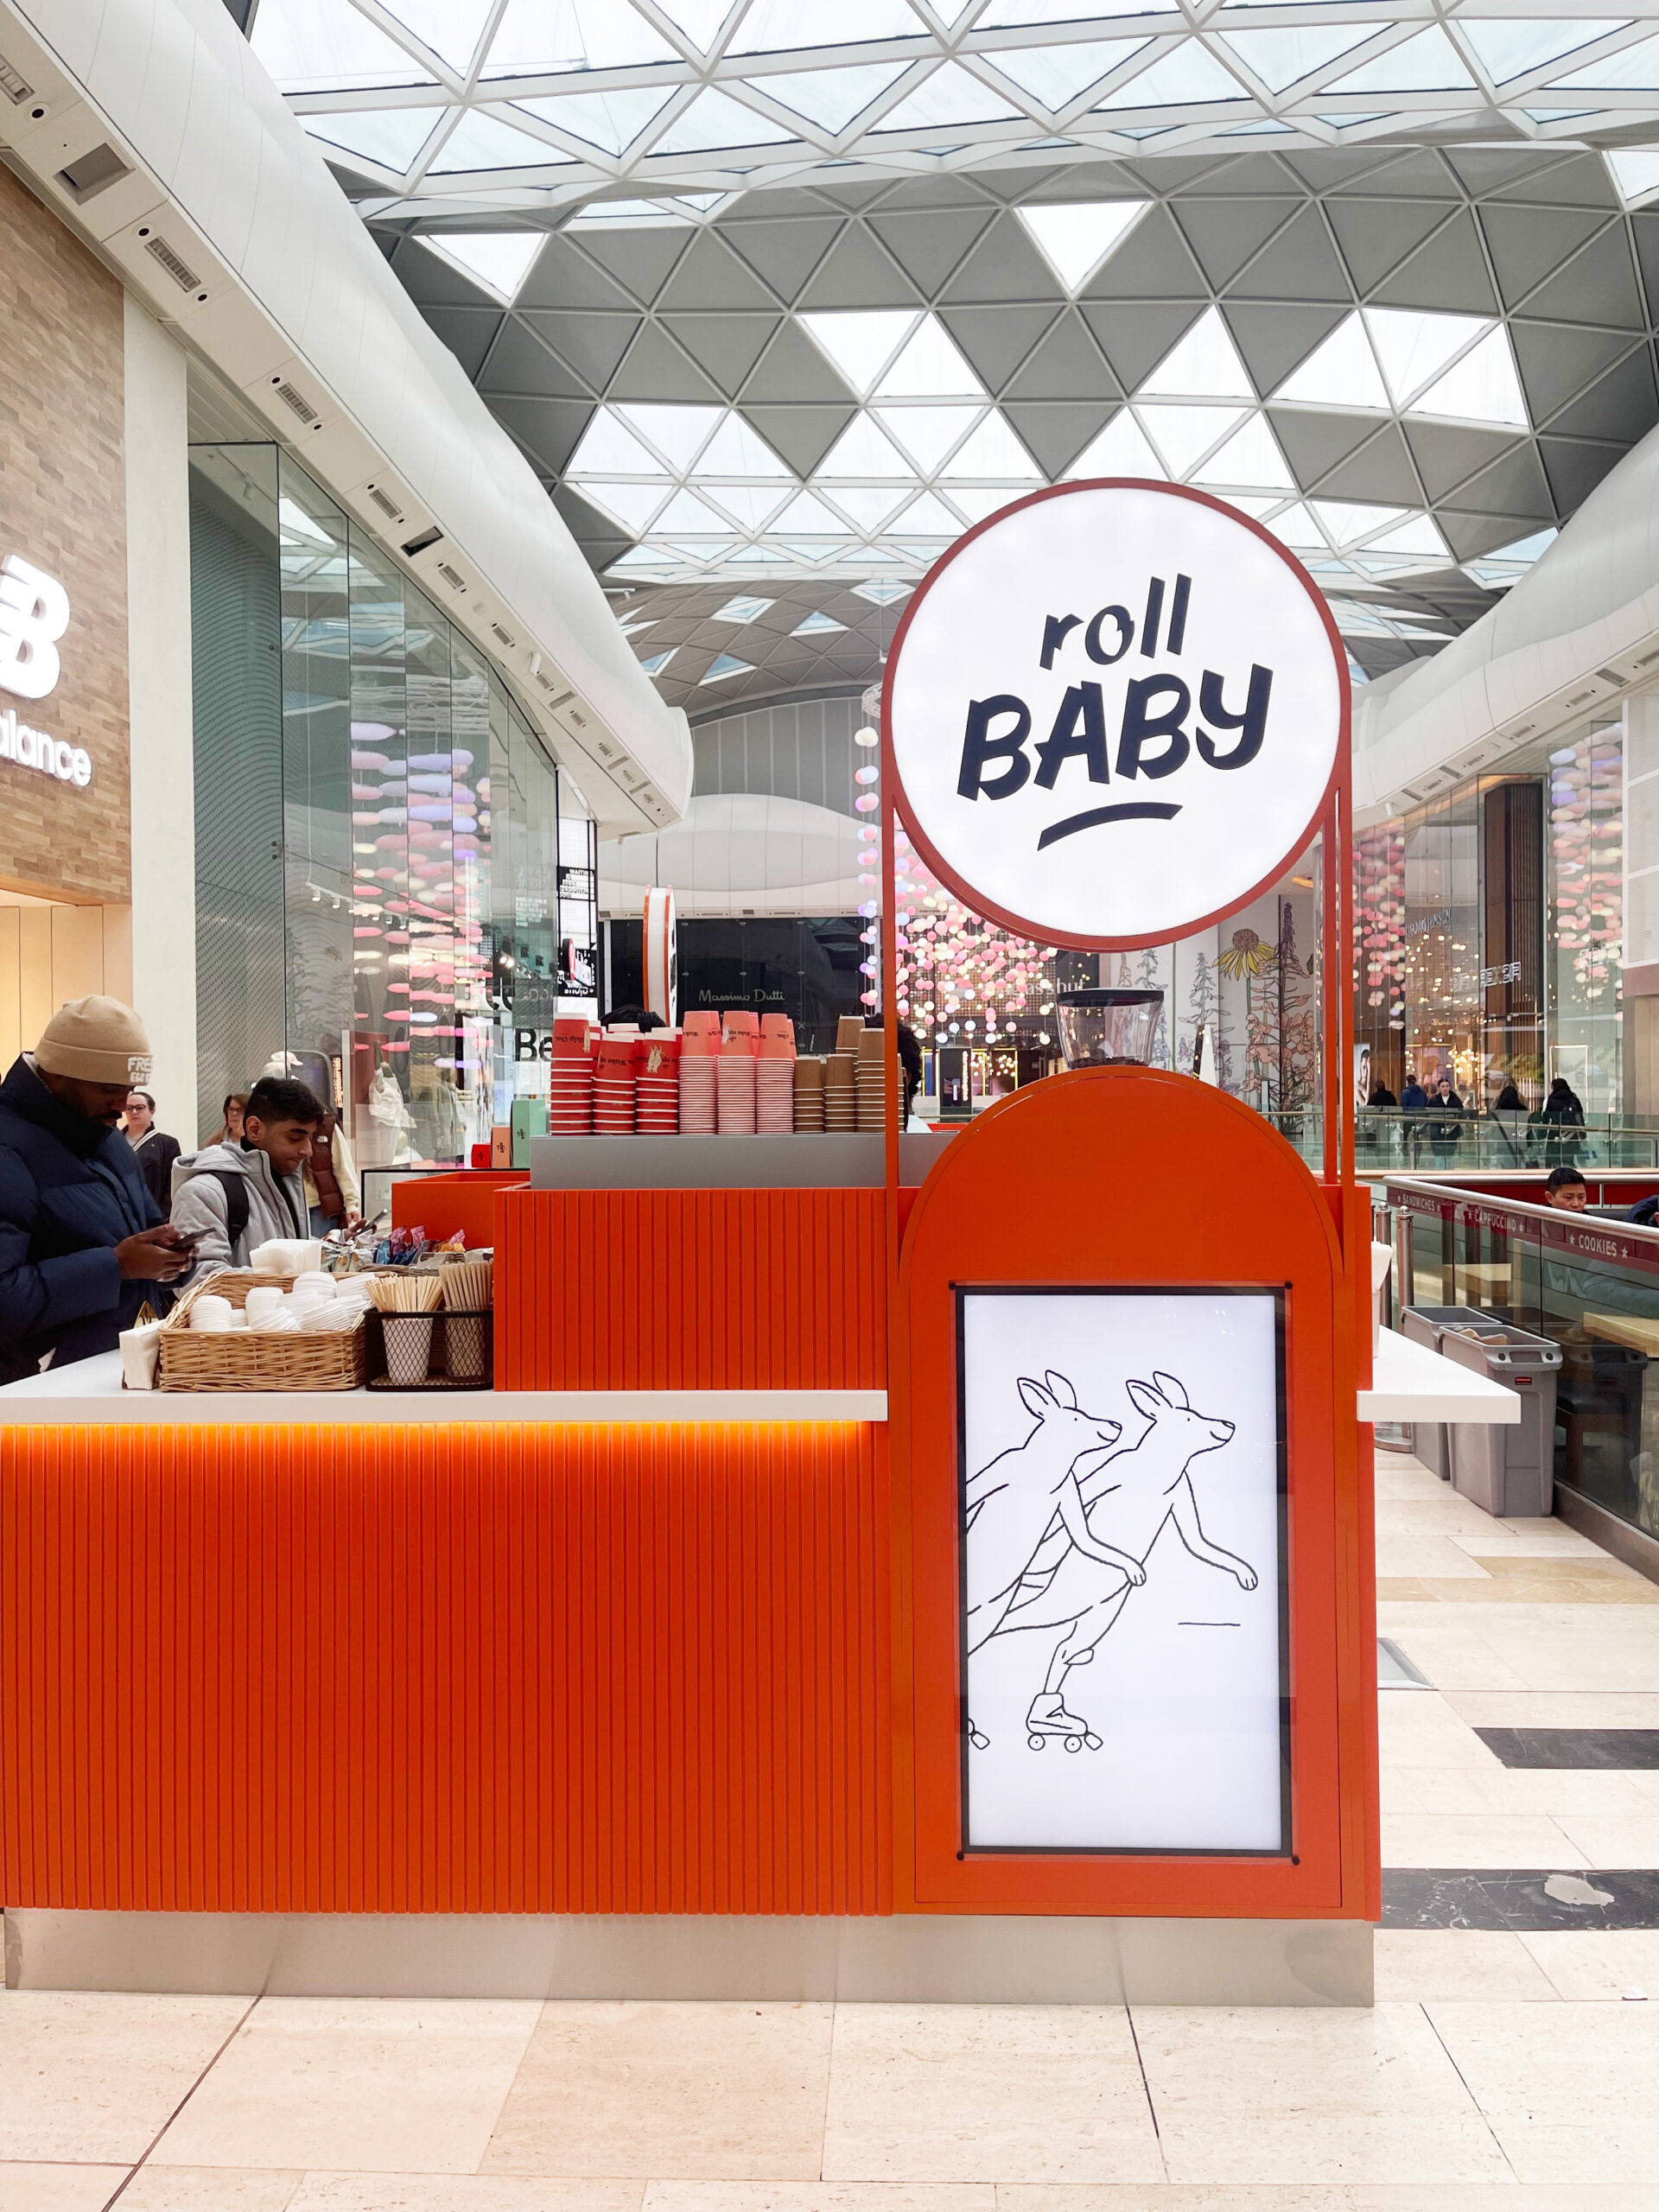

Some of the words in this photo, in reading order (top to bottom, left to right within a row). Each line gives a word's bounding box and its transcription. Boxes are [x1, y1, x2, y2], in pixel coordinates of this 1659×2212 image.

[1039, 573, 1192, 671] roll
[957, 663, 1274, 802] BABY
[698, 988, 751, 1003] Massimo
[753, 988, 785, 1002] Dutti
[1402, 1194, 1435, 1211] SANDWICHES
[1474, 1208, 1517, 1232] CAPPUCCINO
[1579, 1234, 1618, 1257] COOKIES
